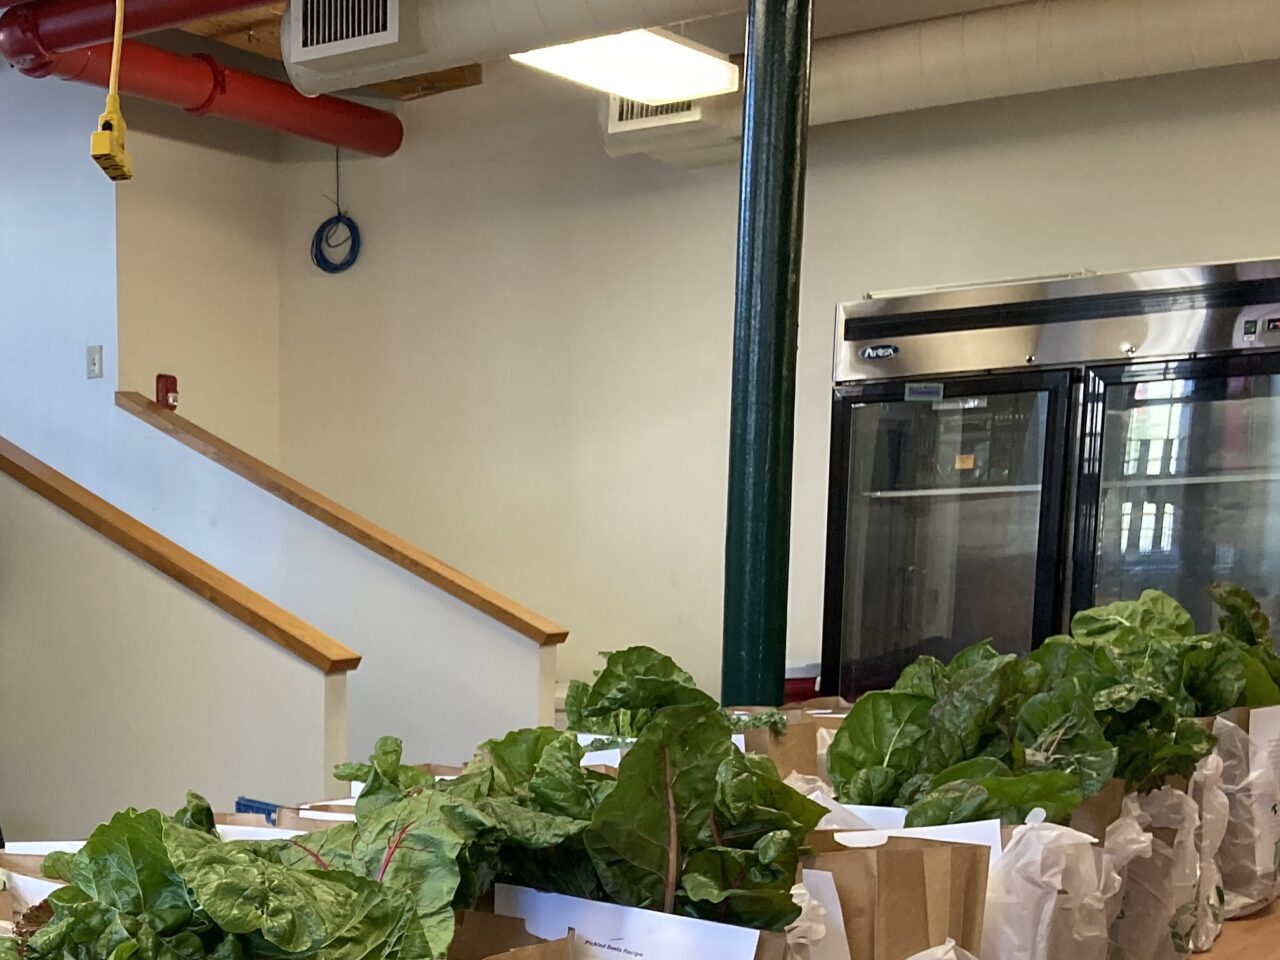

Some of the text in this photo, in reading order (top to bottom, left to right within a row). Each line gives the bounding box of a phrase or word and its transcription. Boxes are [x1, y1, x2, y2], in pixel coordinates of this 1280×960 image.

[584, 939, 644, 957] Pickled Beets Recipe
